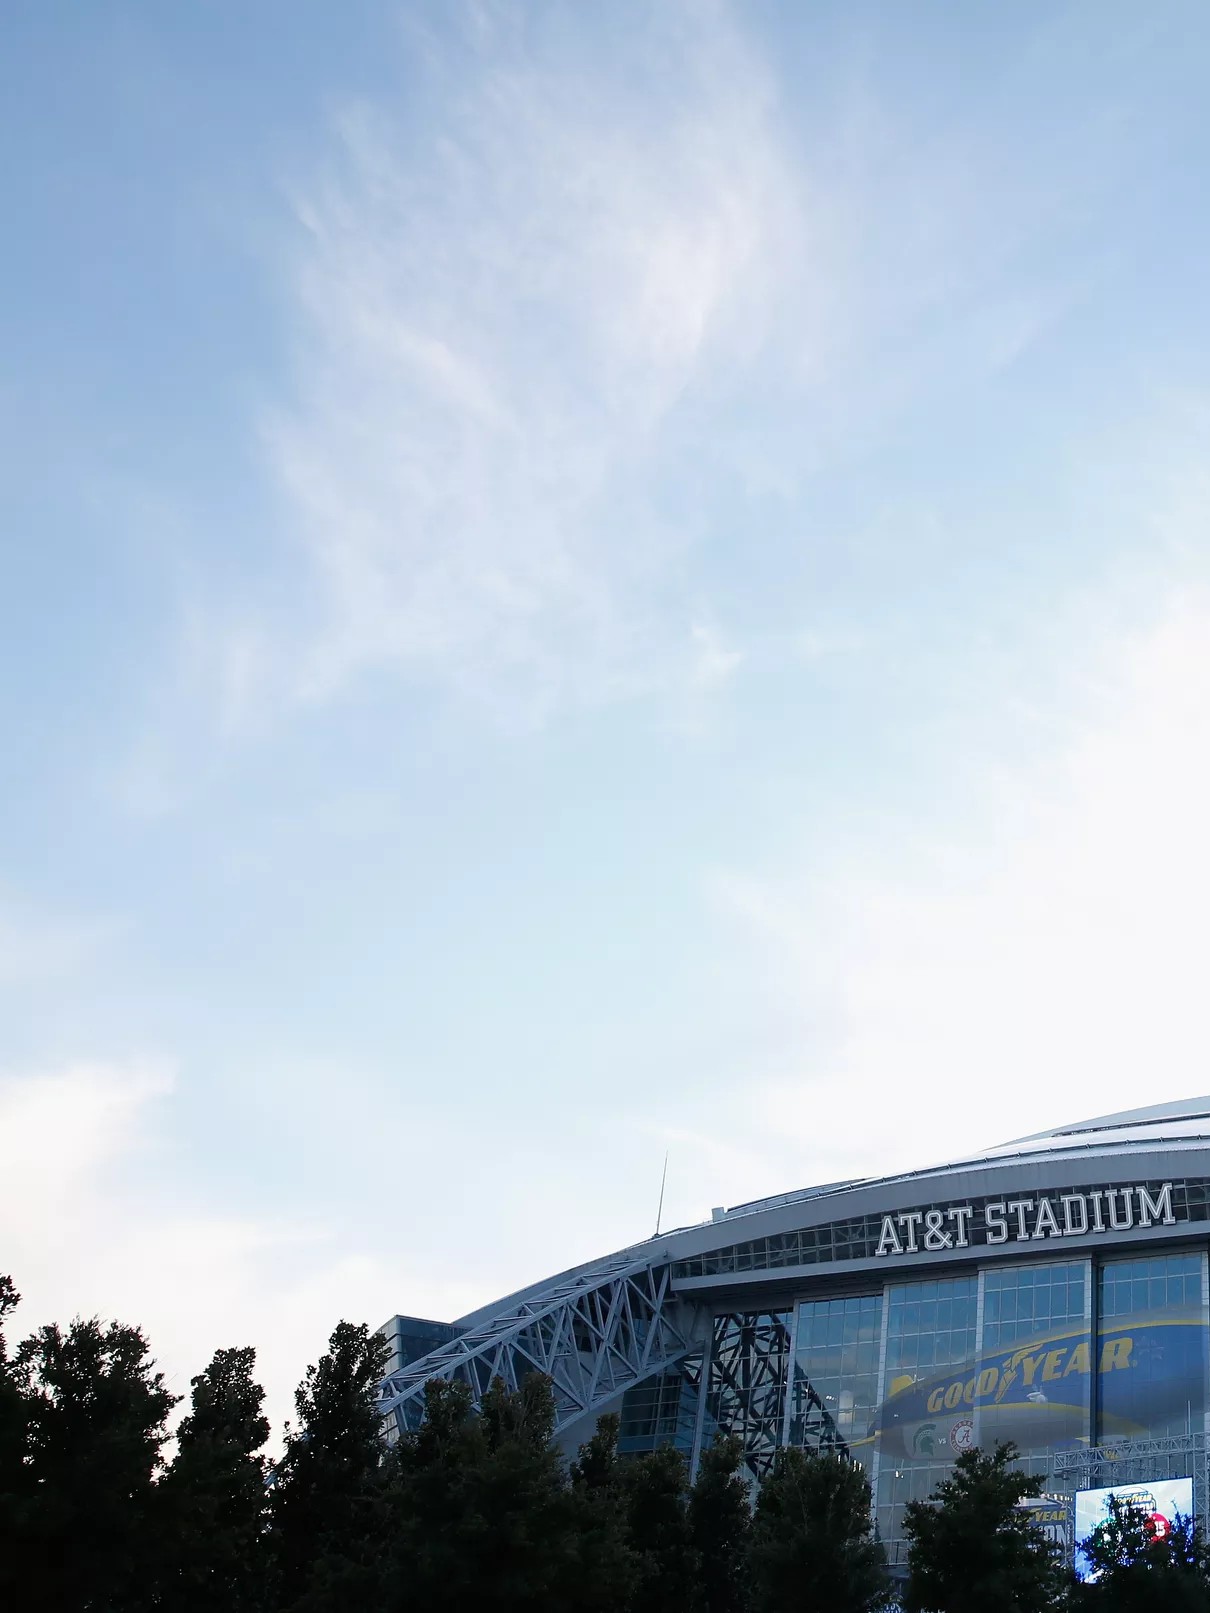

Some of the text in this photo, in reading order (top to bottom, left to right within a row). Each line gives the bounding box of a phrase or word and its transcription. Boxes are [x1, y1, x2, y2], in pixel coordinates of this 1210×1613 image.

[875, 1182, 1176, 1256] AT&T STADIUM
[927, 1337, 1134, 1413] GOODYEAR
[1154, 1521, 1165, 1537] 15
